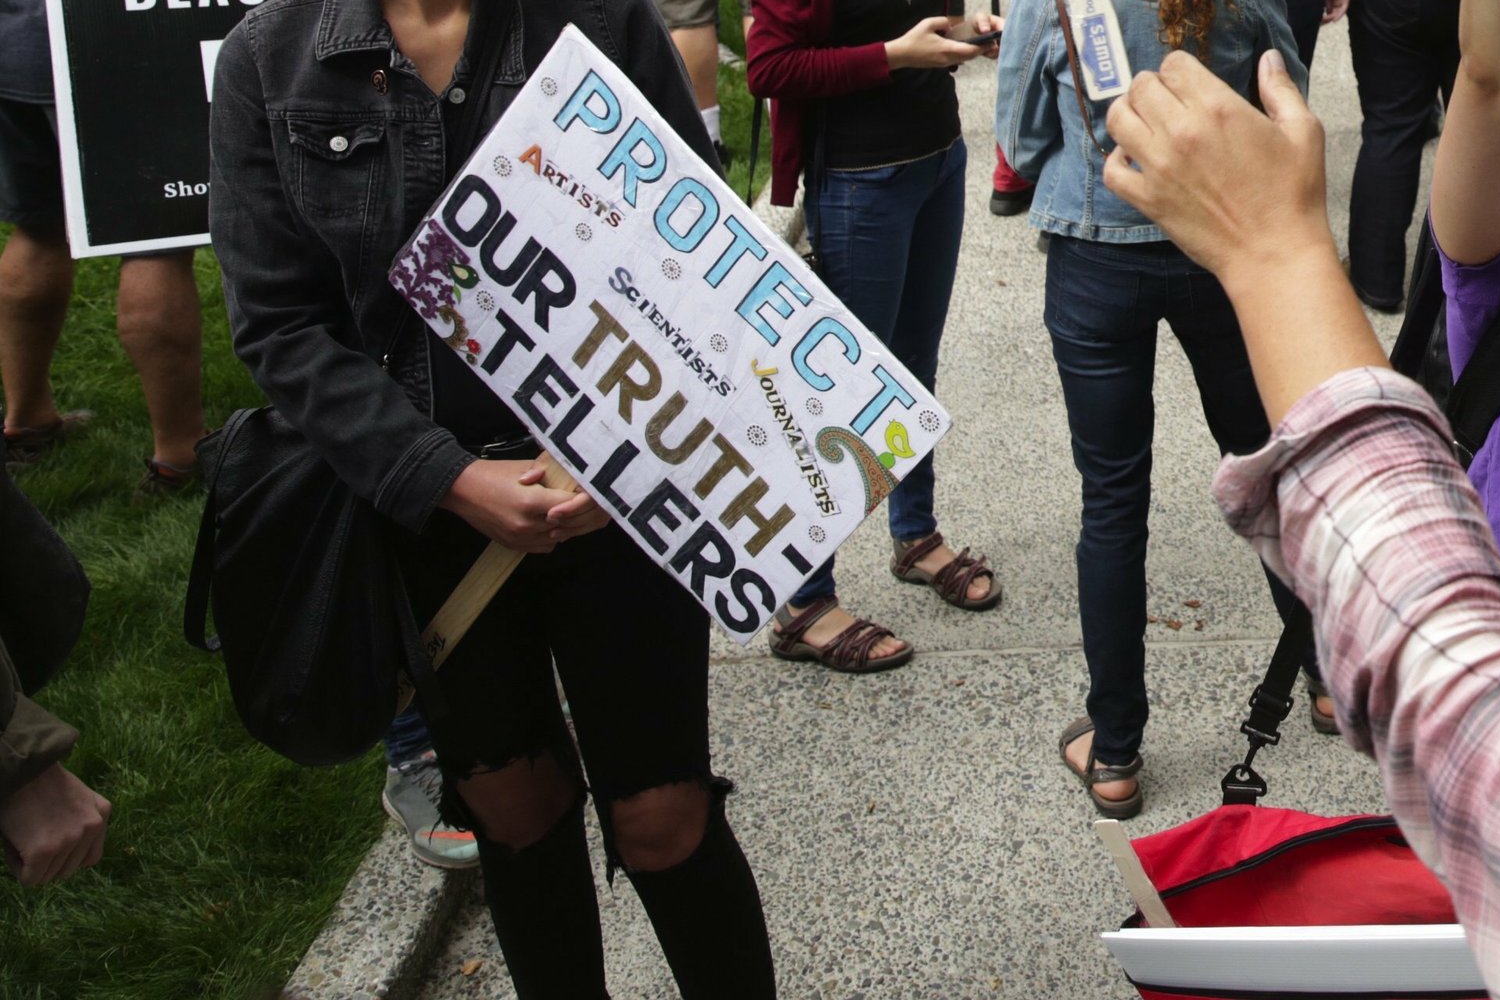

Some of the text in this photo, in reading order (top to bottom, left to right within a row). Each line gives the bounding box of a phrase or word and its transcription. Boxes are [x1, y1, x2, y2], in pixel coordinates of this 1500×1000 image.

[1089, 23, 1115, 82] LOWE'S
[164, 180, 211, 198] Sho
[442, 174, 576, 333] OUR
[518, 143, 623, 228] ARTISTS
[553, 68, 917, 436] PROTECT
[608, 266, 732, 398] SCIENTISTS
[478, 306, 777, 634] TELLERS
[751, 358, 837, 515] JOURNALISTS
